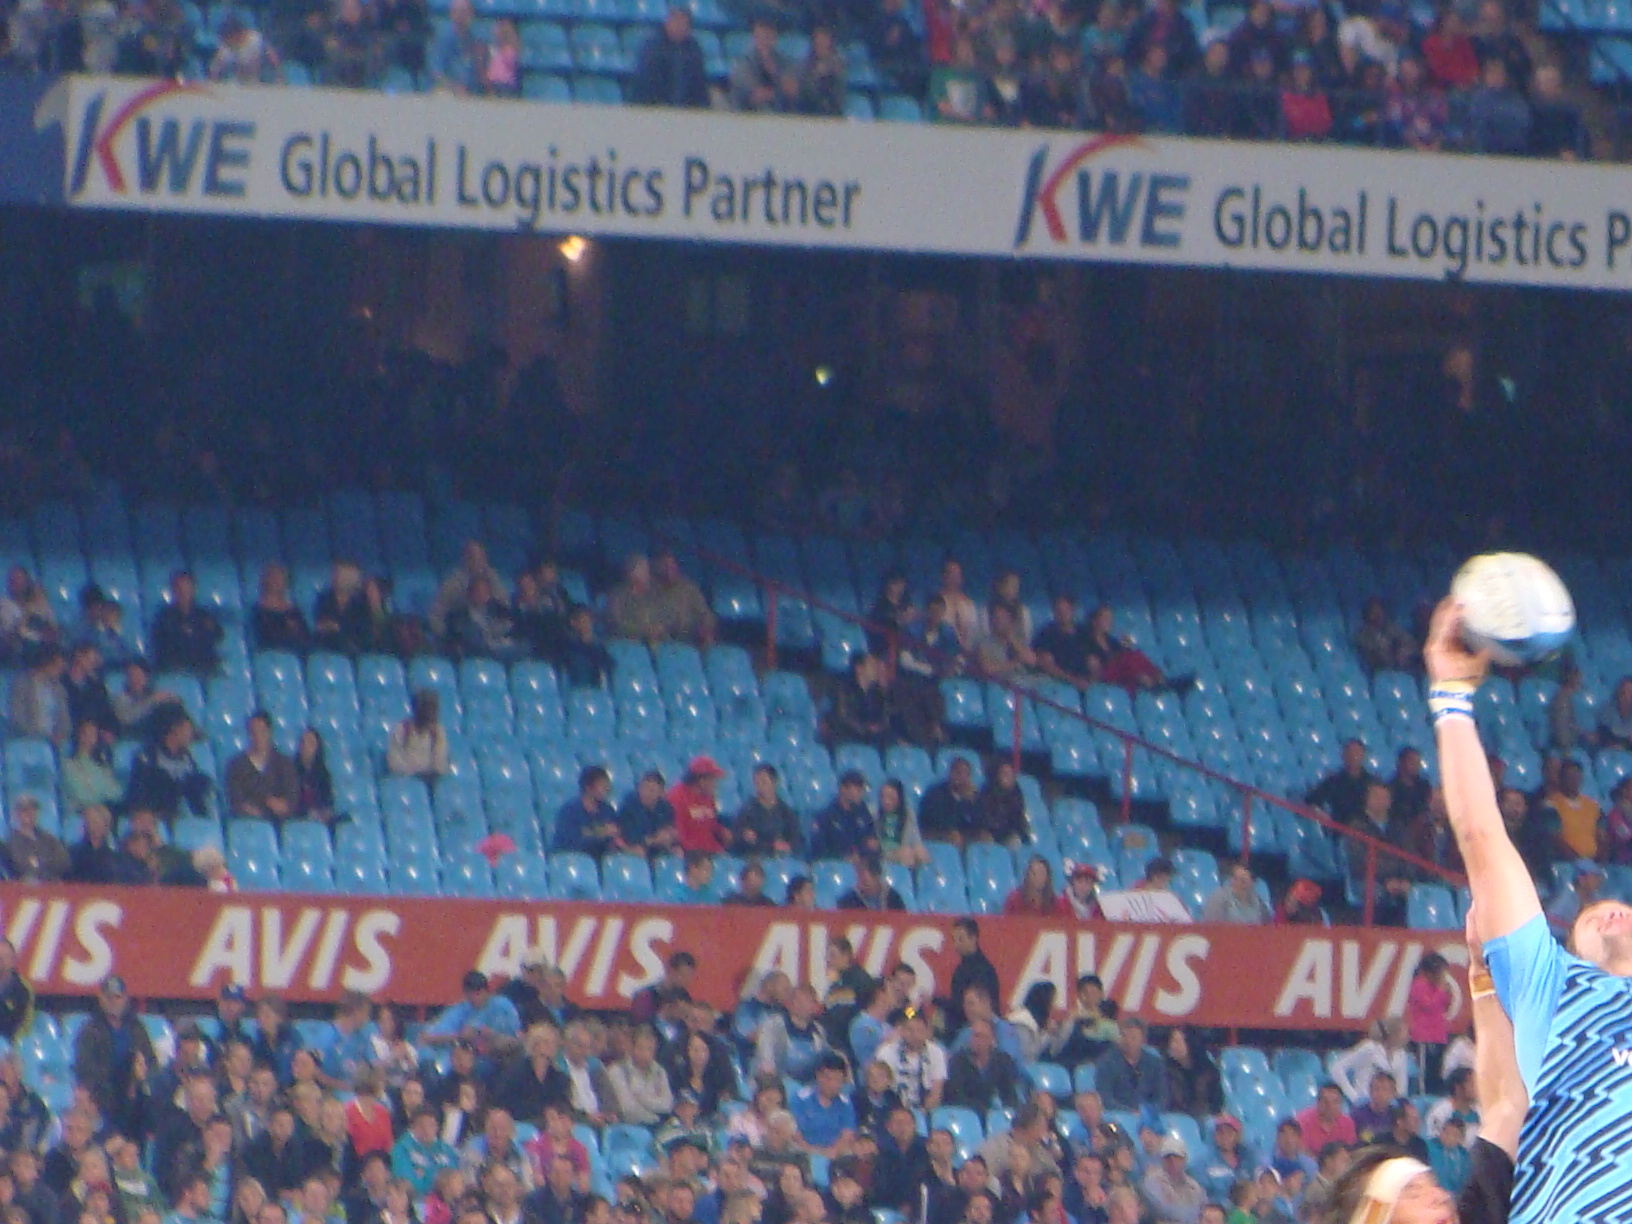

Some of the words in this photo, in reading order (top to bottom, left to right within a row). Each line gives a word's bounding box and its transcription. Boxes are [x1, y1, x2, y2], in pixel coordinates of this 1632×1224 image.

[69, 80, 256, 198] KWE
[280, 133, 437, 206] Global
[456, 142, 665, 231] Logistics
[683, 157, 863, 229] Partner
[1014, 133, 1190, 248] KWE
[1212, 184, 1369, 256] Global
[1386, 196, 1588, 281] Logistics
[190, 904, 400, 993] AVIS
[475, 912, 674, 1000] AVIS
[740, 920, 945, 1008] AVIS
[1008, 928, 1210, 1018] AVIS
